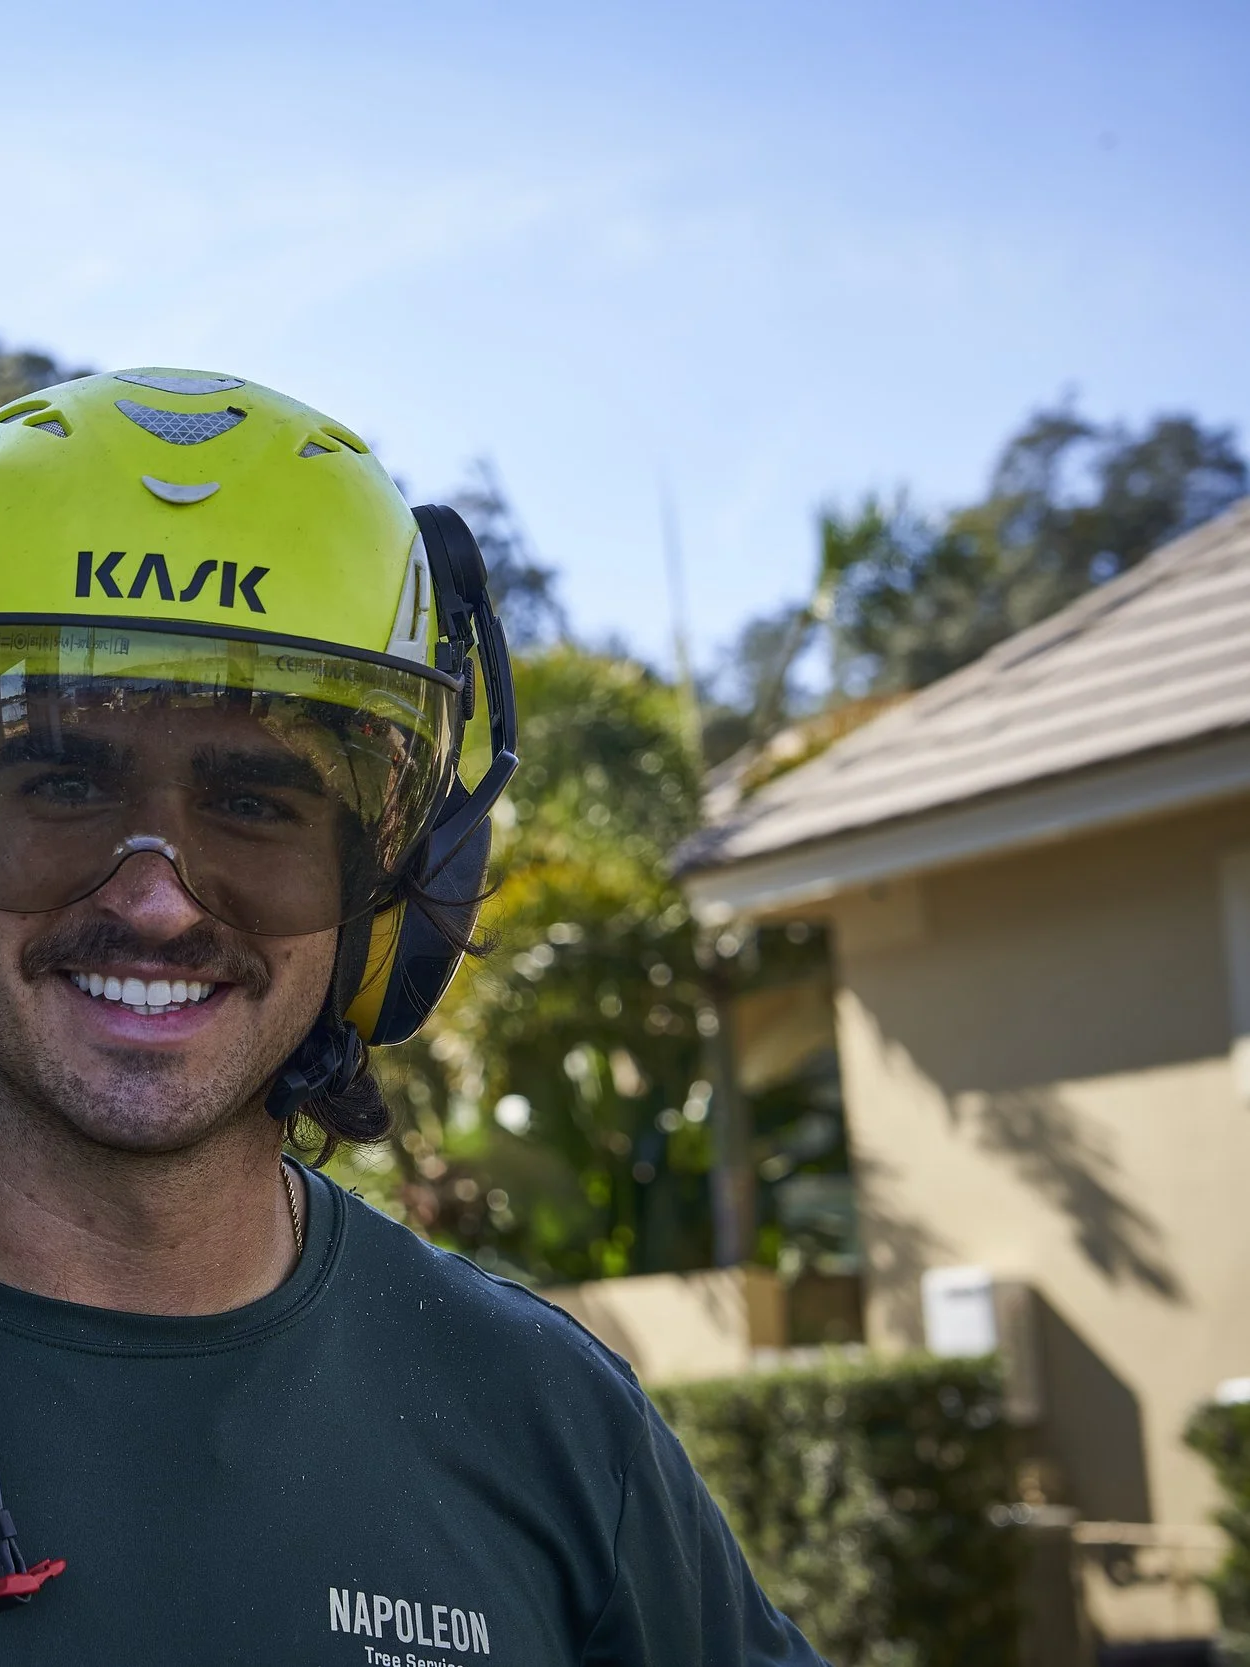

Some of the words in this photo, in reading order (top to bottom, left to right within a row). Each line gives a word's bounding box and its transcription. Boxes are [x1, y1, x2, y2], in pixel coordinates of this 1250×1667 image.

[75, 551, 270, 614] KASK
[329, 1587, 490, 1655] NAPOLEON
[364, 1645, 401, 1667] Tree
[406, 1653, 464, 1667] Servi
